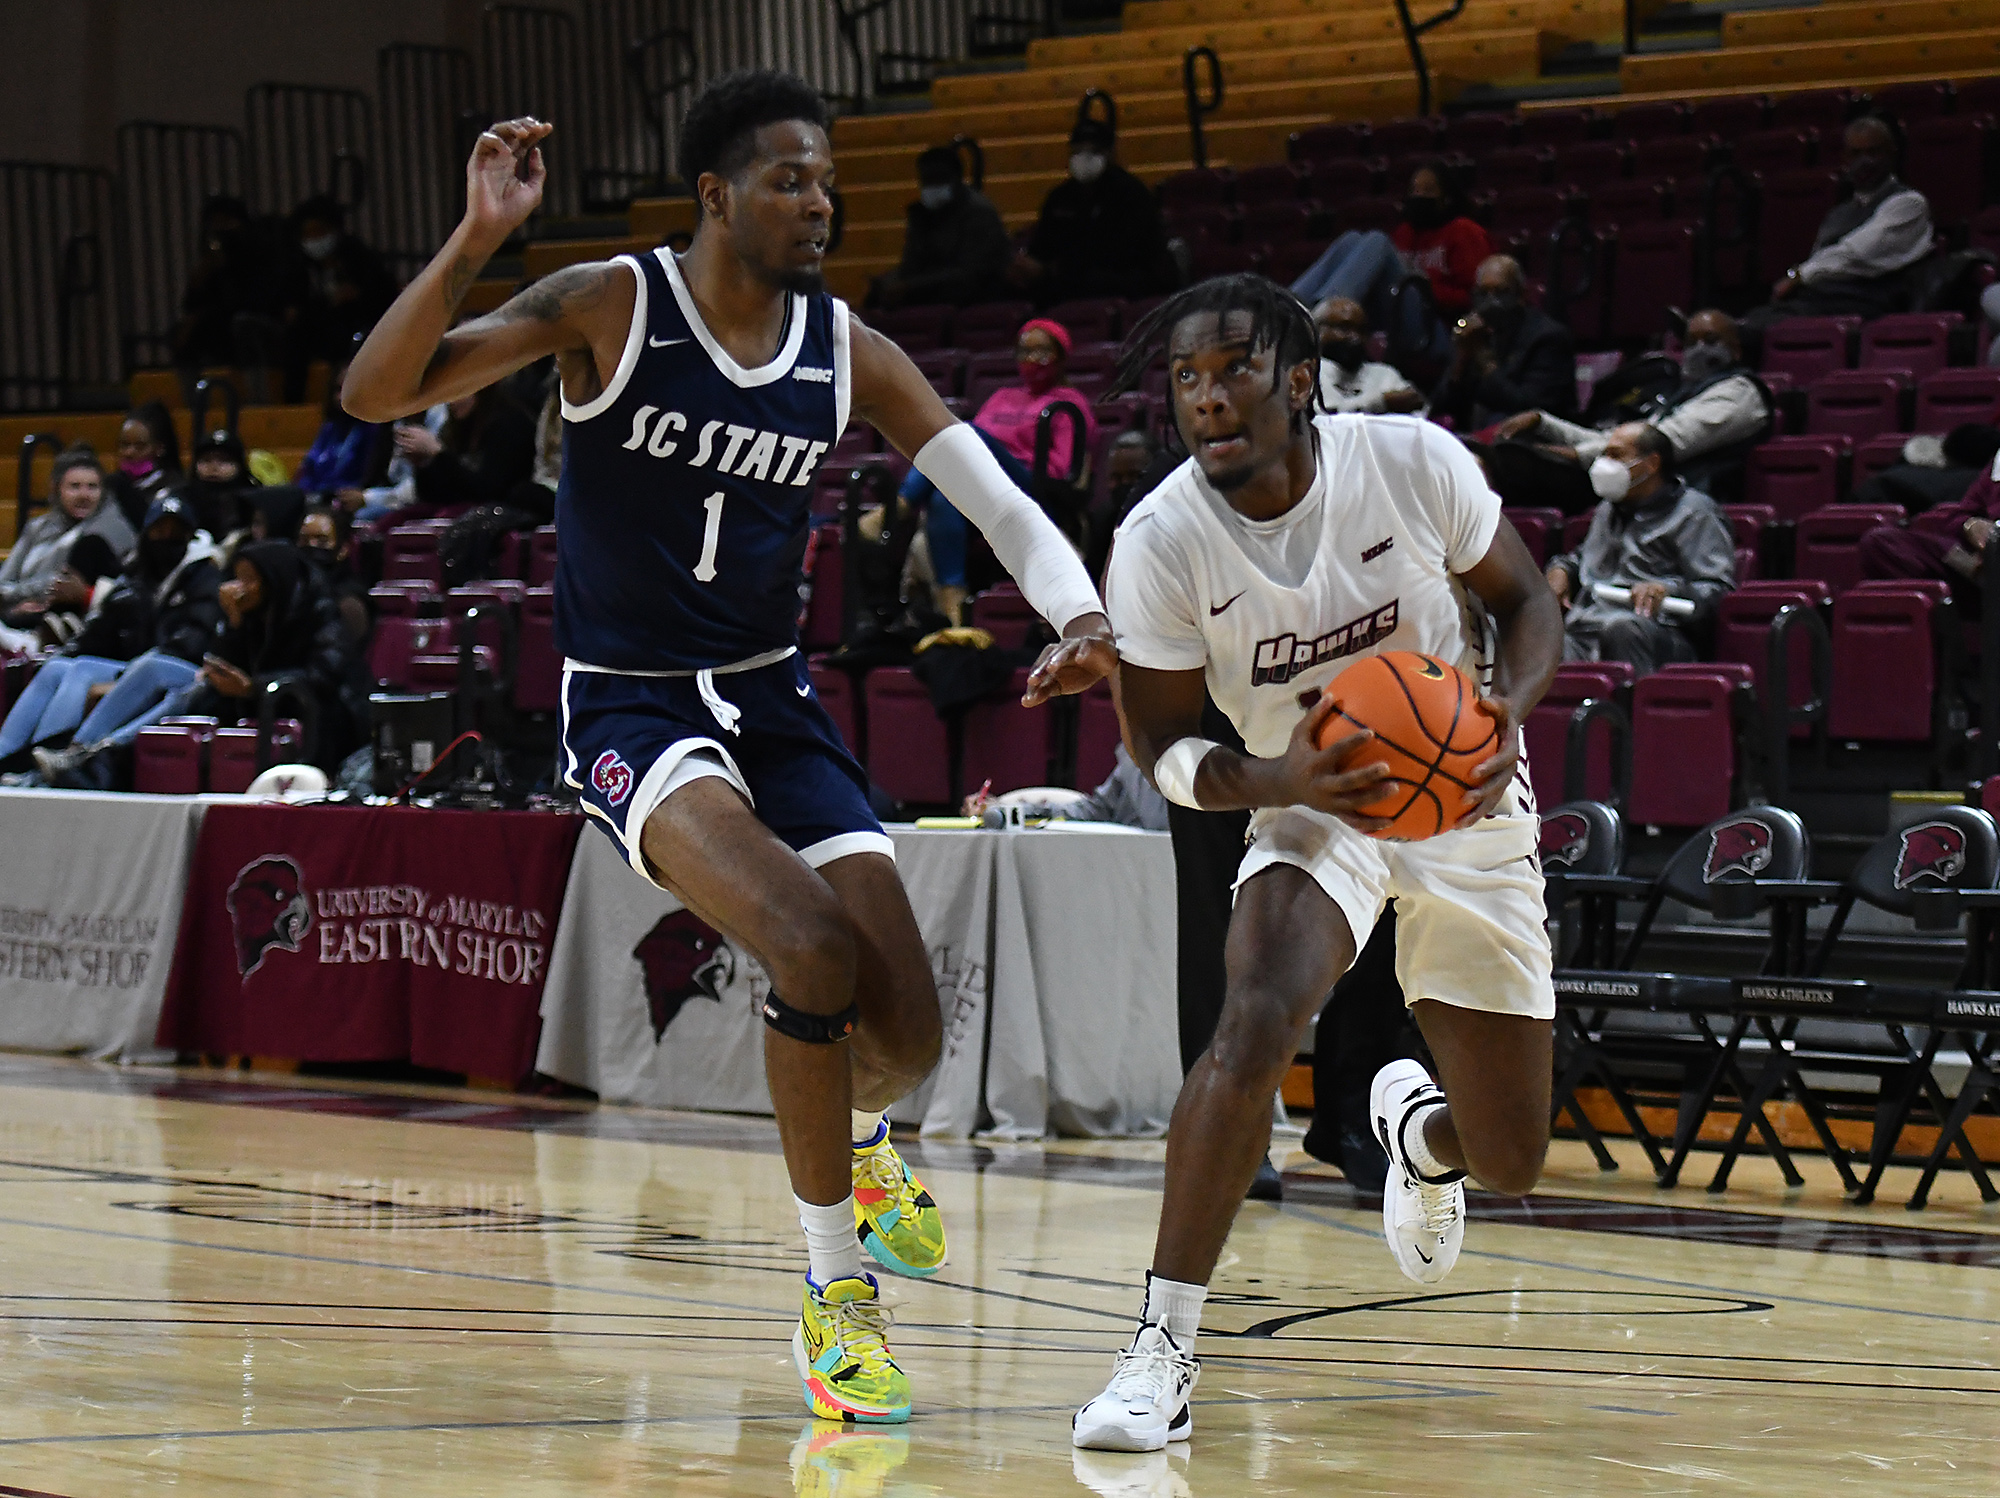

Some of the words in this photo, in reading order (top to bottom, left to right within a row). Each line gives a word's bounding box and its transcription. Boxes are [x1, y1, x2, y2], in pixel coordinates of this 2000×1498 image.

[621, 404, 687, 458] SC
[688, 420, 829, 487] STATE
[692, 491, 725, 582] 1
[318, 917, 452, 970] EASTRN
[1946, 999, 1987, 1017] HAWKS
